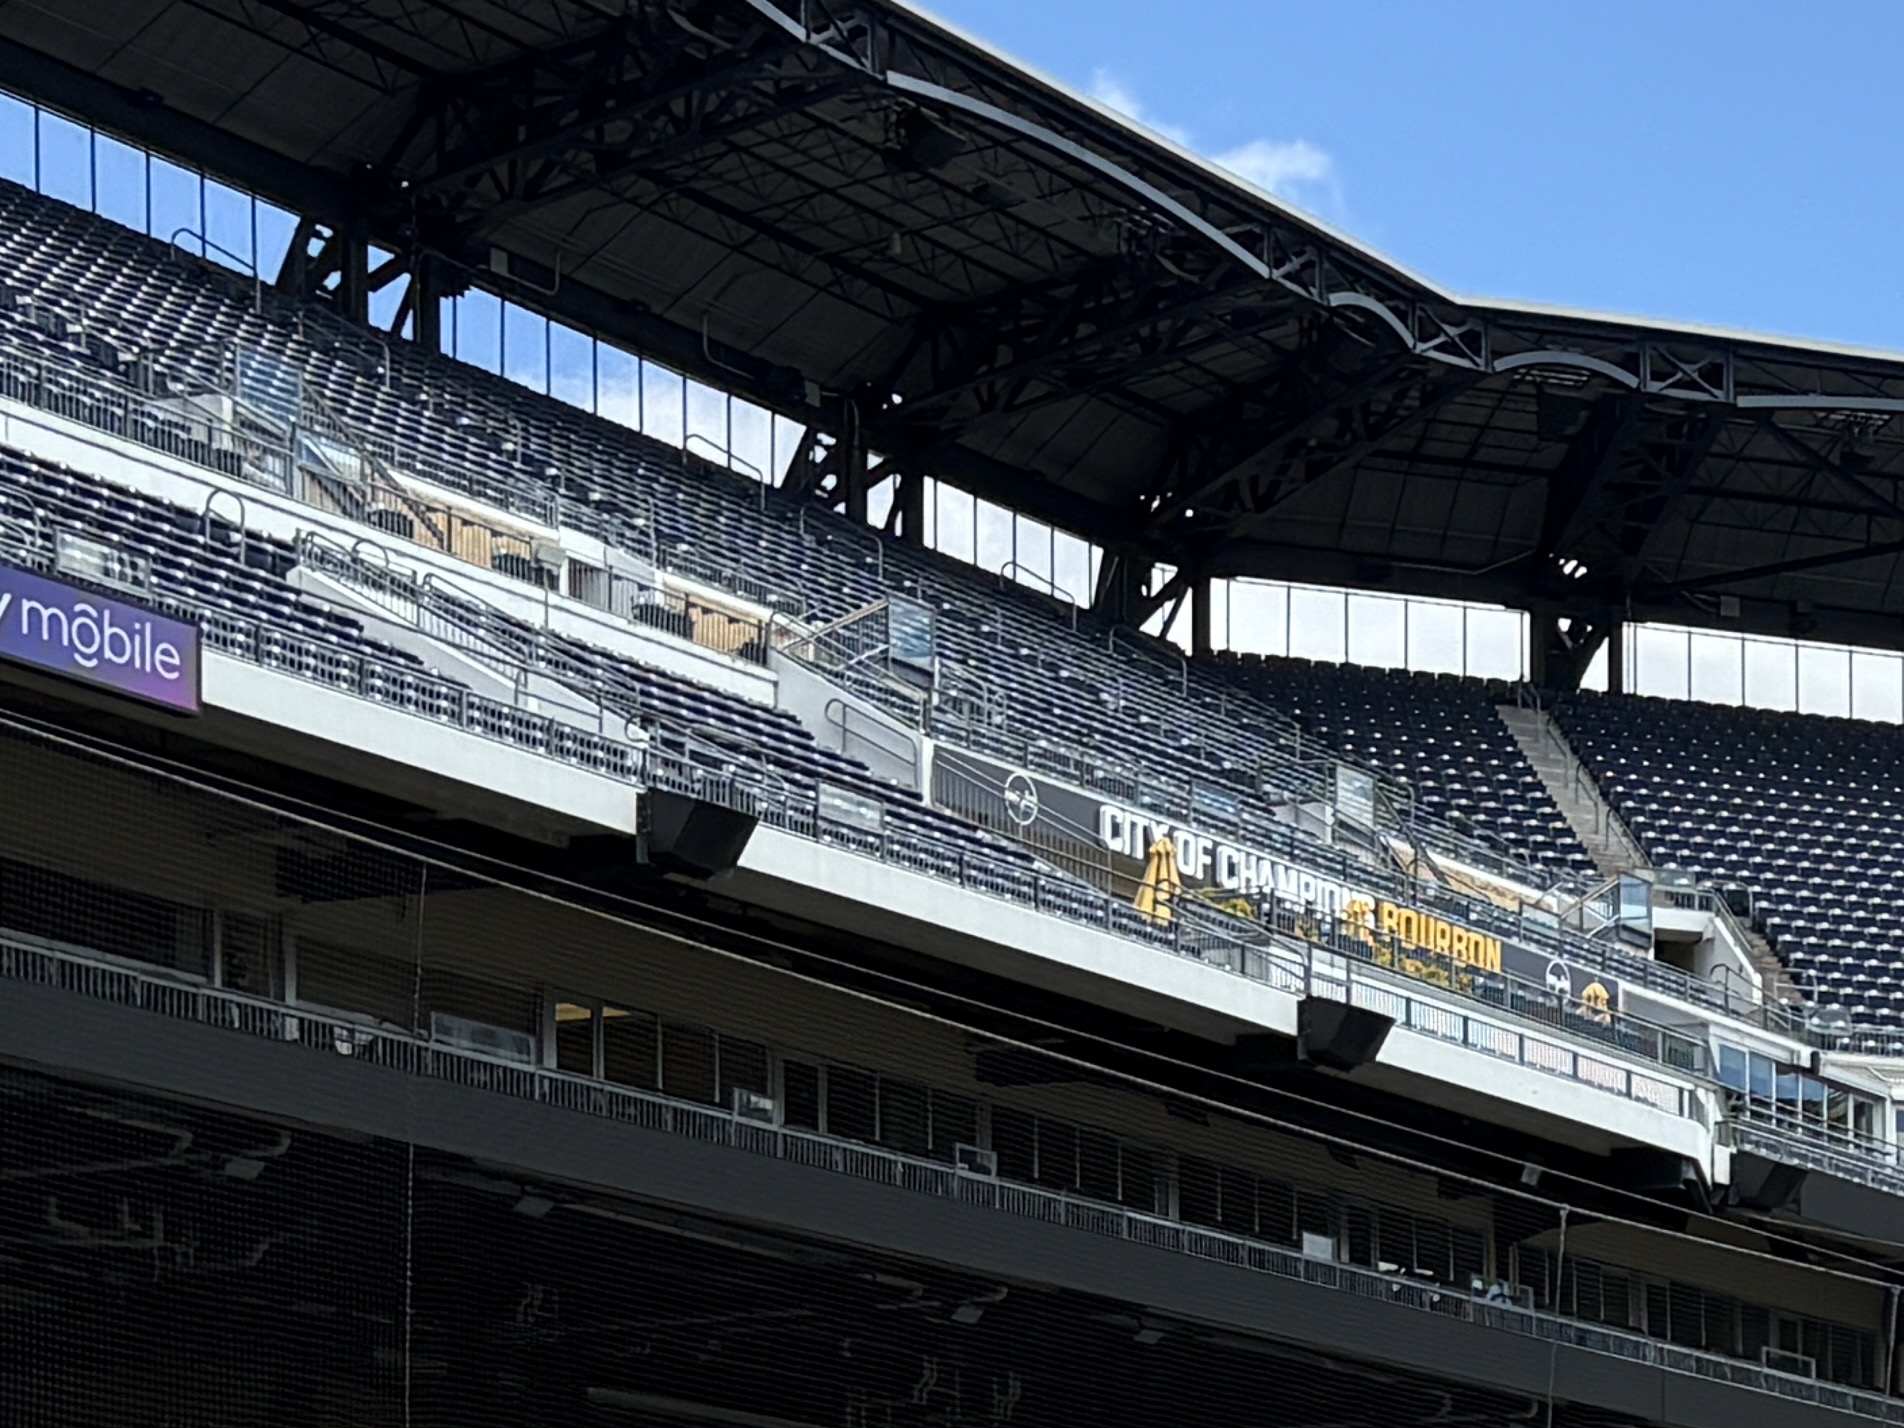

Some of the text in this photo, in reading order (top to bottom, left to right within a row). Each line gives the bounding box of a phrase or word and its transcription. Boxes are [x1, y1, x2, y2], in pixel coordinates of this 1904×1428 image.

[22, 598, 181, 680] mobile
[1100, 804, 1172, 861] CITY
[1173, 829, 1214, 880] OF
[1383, 902, 1501, 973] BOURBON
